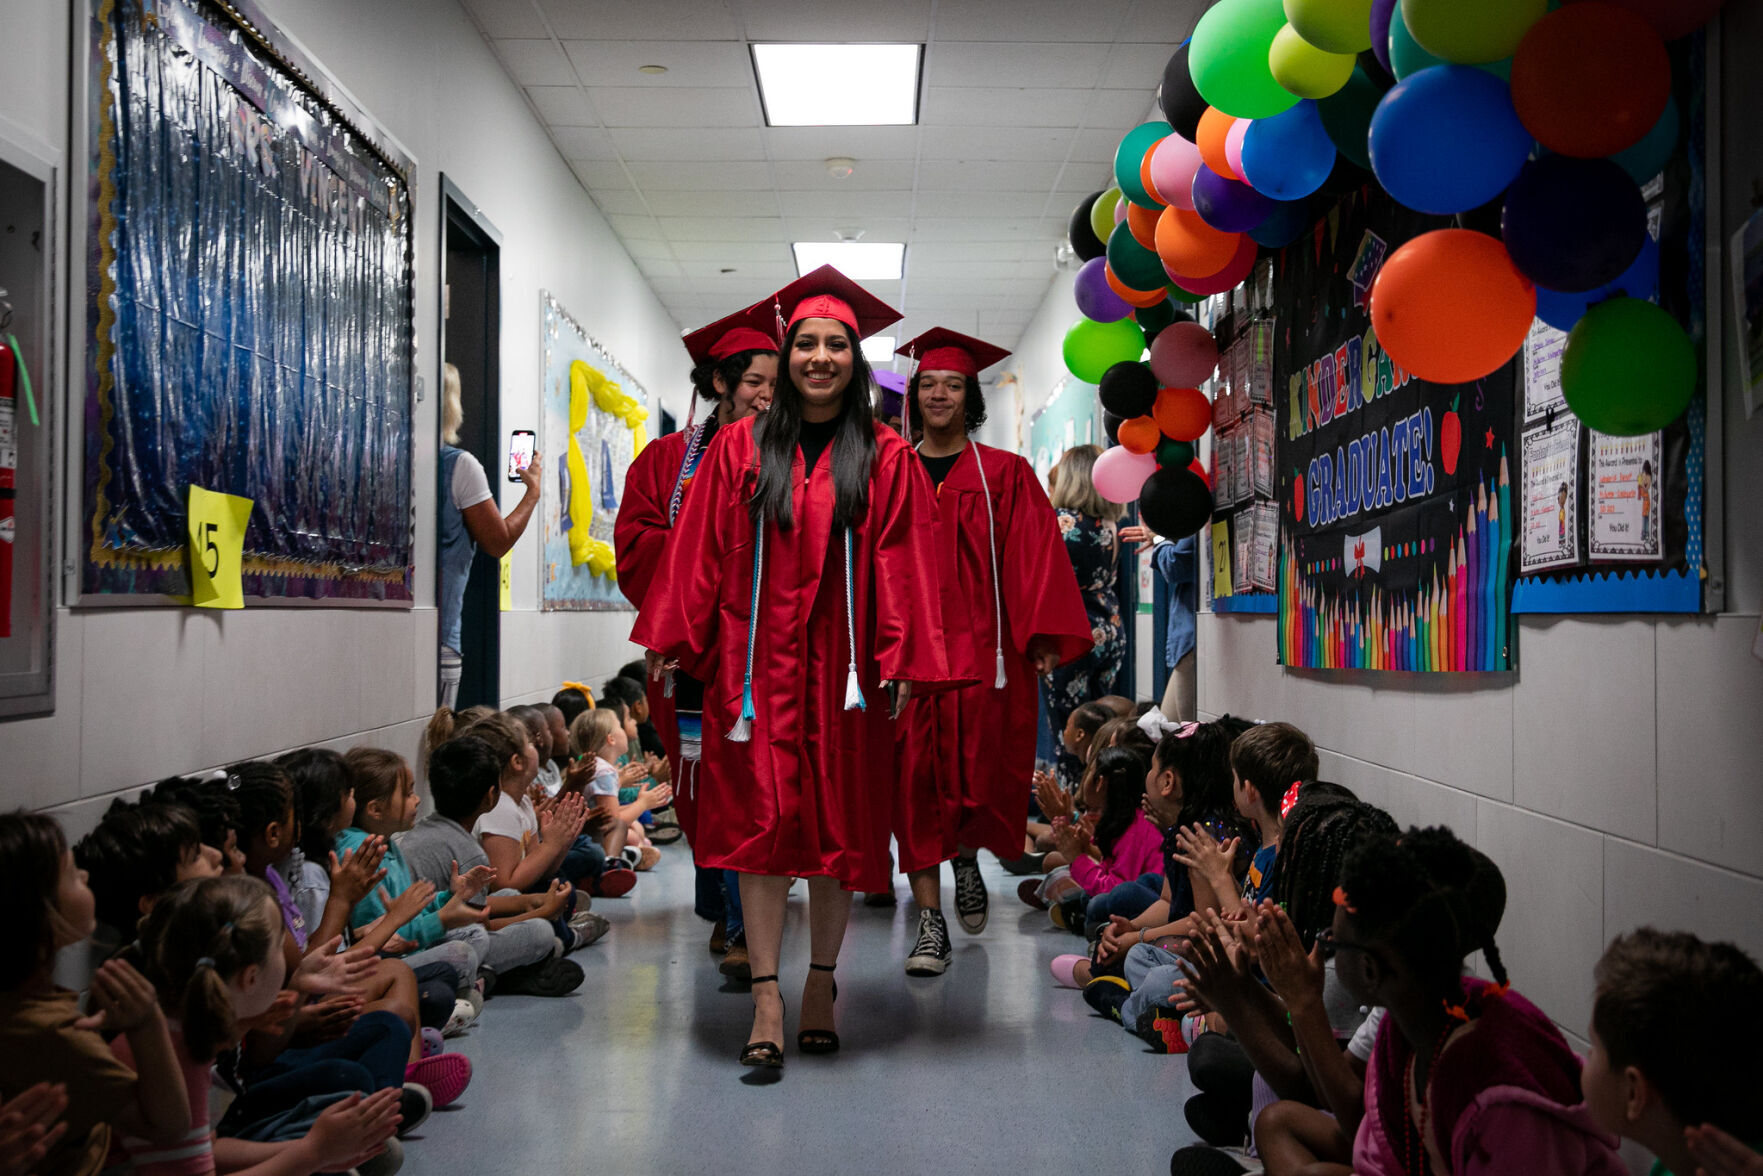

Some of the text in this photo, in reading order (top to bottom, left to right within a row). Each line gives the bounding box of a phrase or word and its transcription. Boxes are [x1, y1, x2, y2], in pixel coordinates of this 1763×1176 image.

[1307, 406, 1434, 528] GRADUATE!
[197, 521, 219, 579] 15
[1609, 523, 1617, 532] You
[1617, 523, 1625, 532] Did
